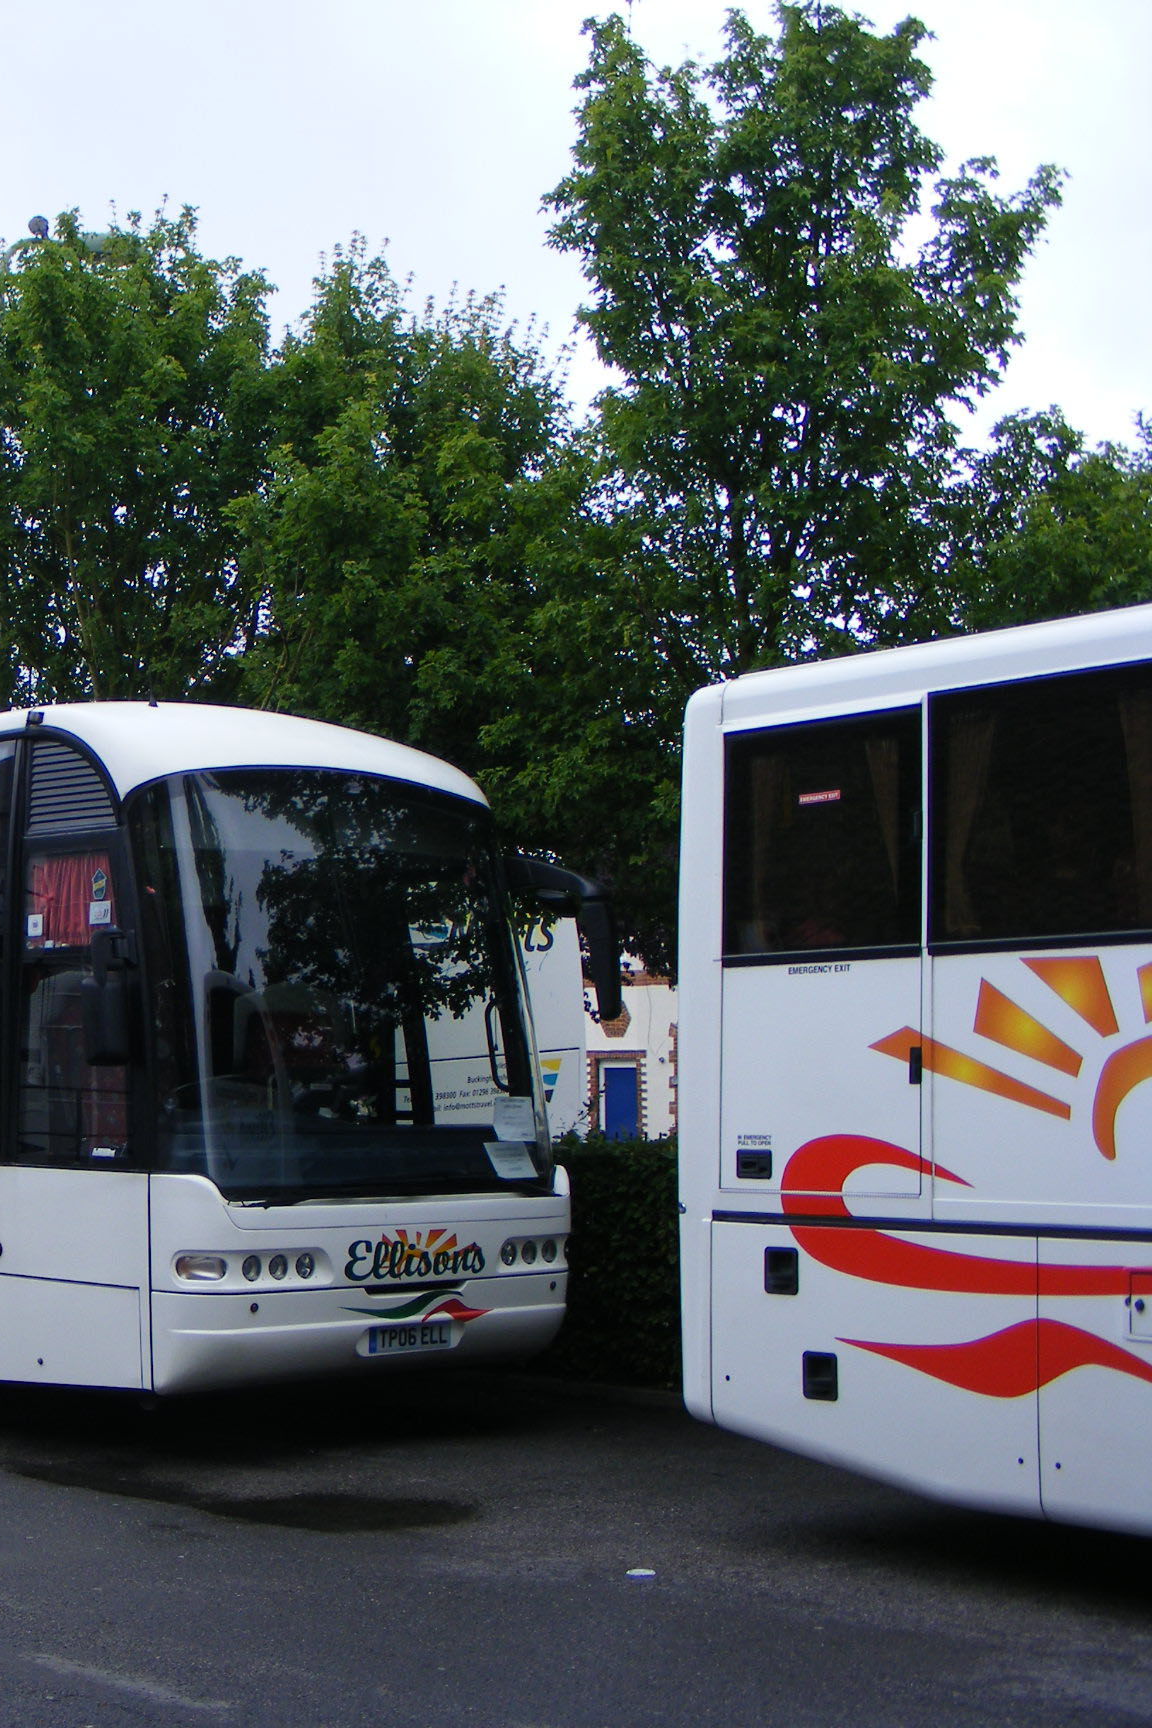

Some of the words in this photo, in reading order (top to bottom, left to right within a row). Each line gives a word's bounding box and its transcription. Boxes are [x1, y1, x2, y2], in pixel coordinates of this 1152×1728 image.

[799, 794, 828, 803] EMERGENCY
[828, 792, 839, 800] EXIT
[788, 965, 833, 975] EMERGENCY
[834, 963, 851, 973] EXIT
[380, 1326, 416, 1349] TP06
[420, 1325, 448, 1345] ELL
